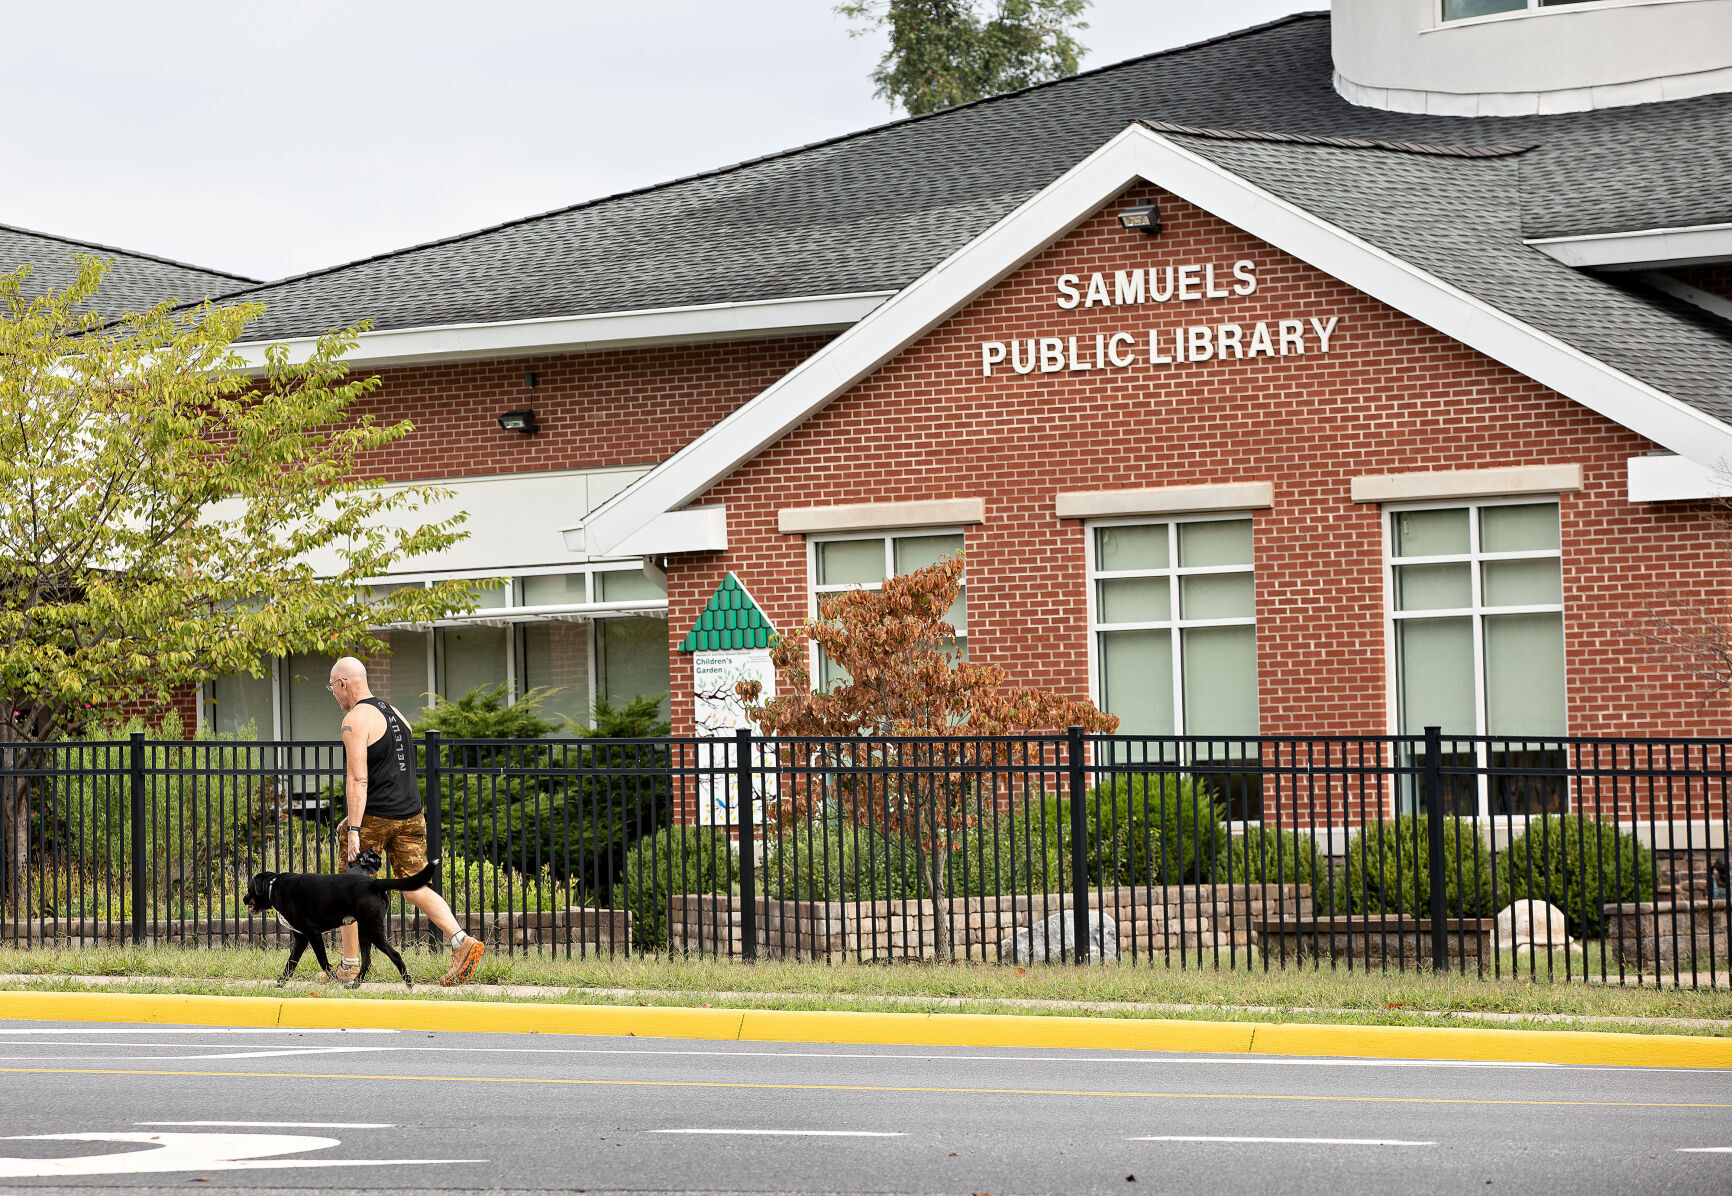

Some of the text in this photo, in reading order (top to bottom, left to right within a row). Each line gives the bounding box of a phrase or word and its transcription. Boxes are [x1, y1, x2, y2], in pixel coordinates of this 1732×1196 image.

[1057, 259, 1257, 309] SAMUELS
[982, 316, 1339, 377] PUBLIC LIBRARY
[696, 658, 733, 666] Children's
[388, 715, 407, 772] NELEUS
